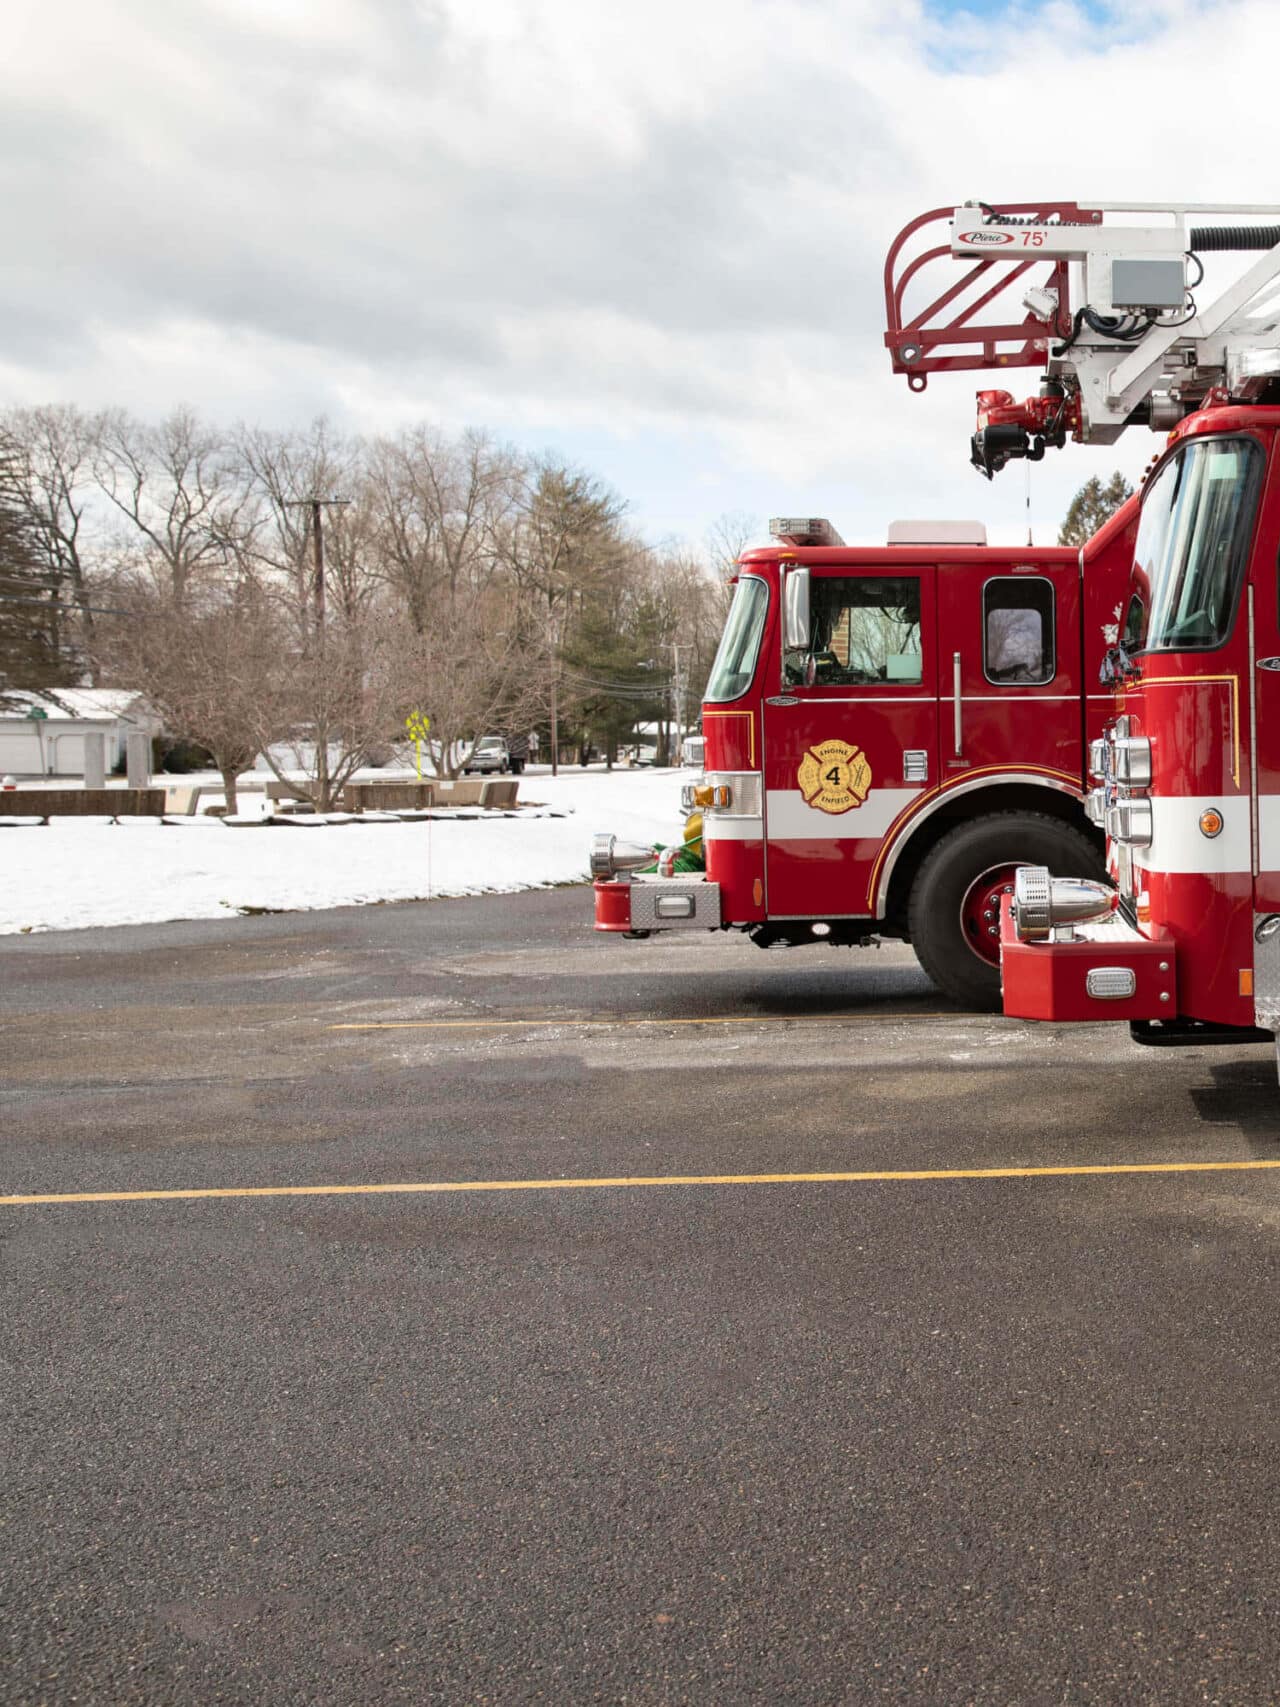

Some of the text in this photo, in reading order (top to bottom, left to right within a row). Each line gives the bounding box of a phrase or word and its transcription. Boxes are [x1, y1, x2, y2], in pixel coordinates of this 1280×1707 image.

[971, 231, 1002, 243] Pierce
[820, 747, 849, 757] ENGINE
[826, 766, 841, 786] 4
[820, 795, 850, 805] ENFIELD
